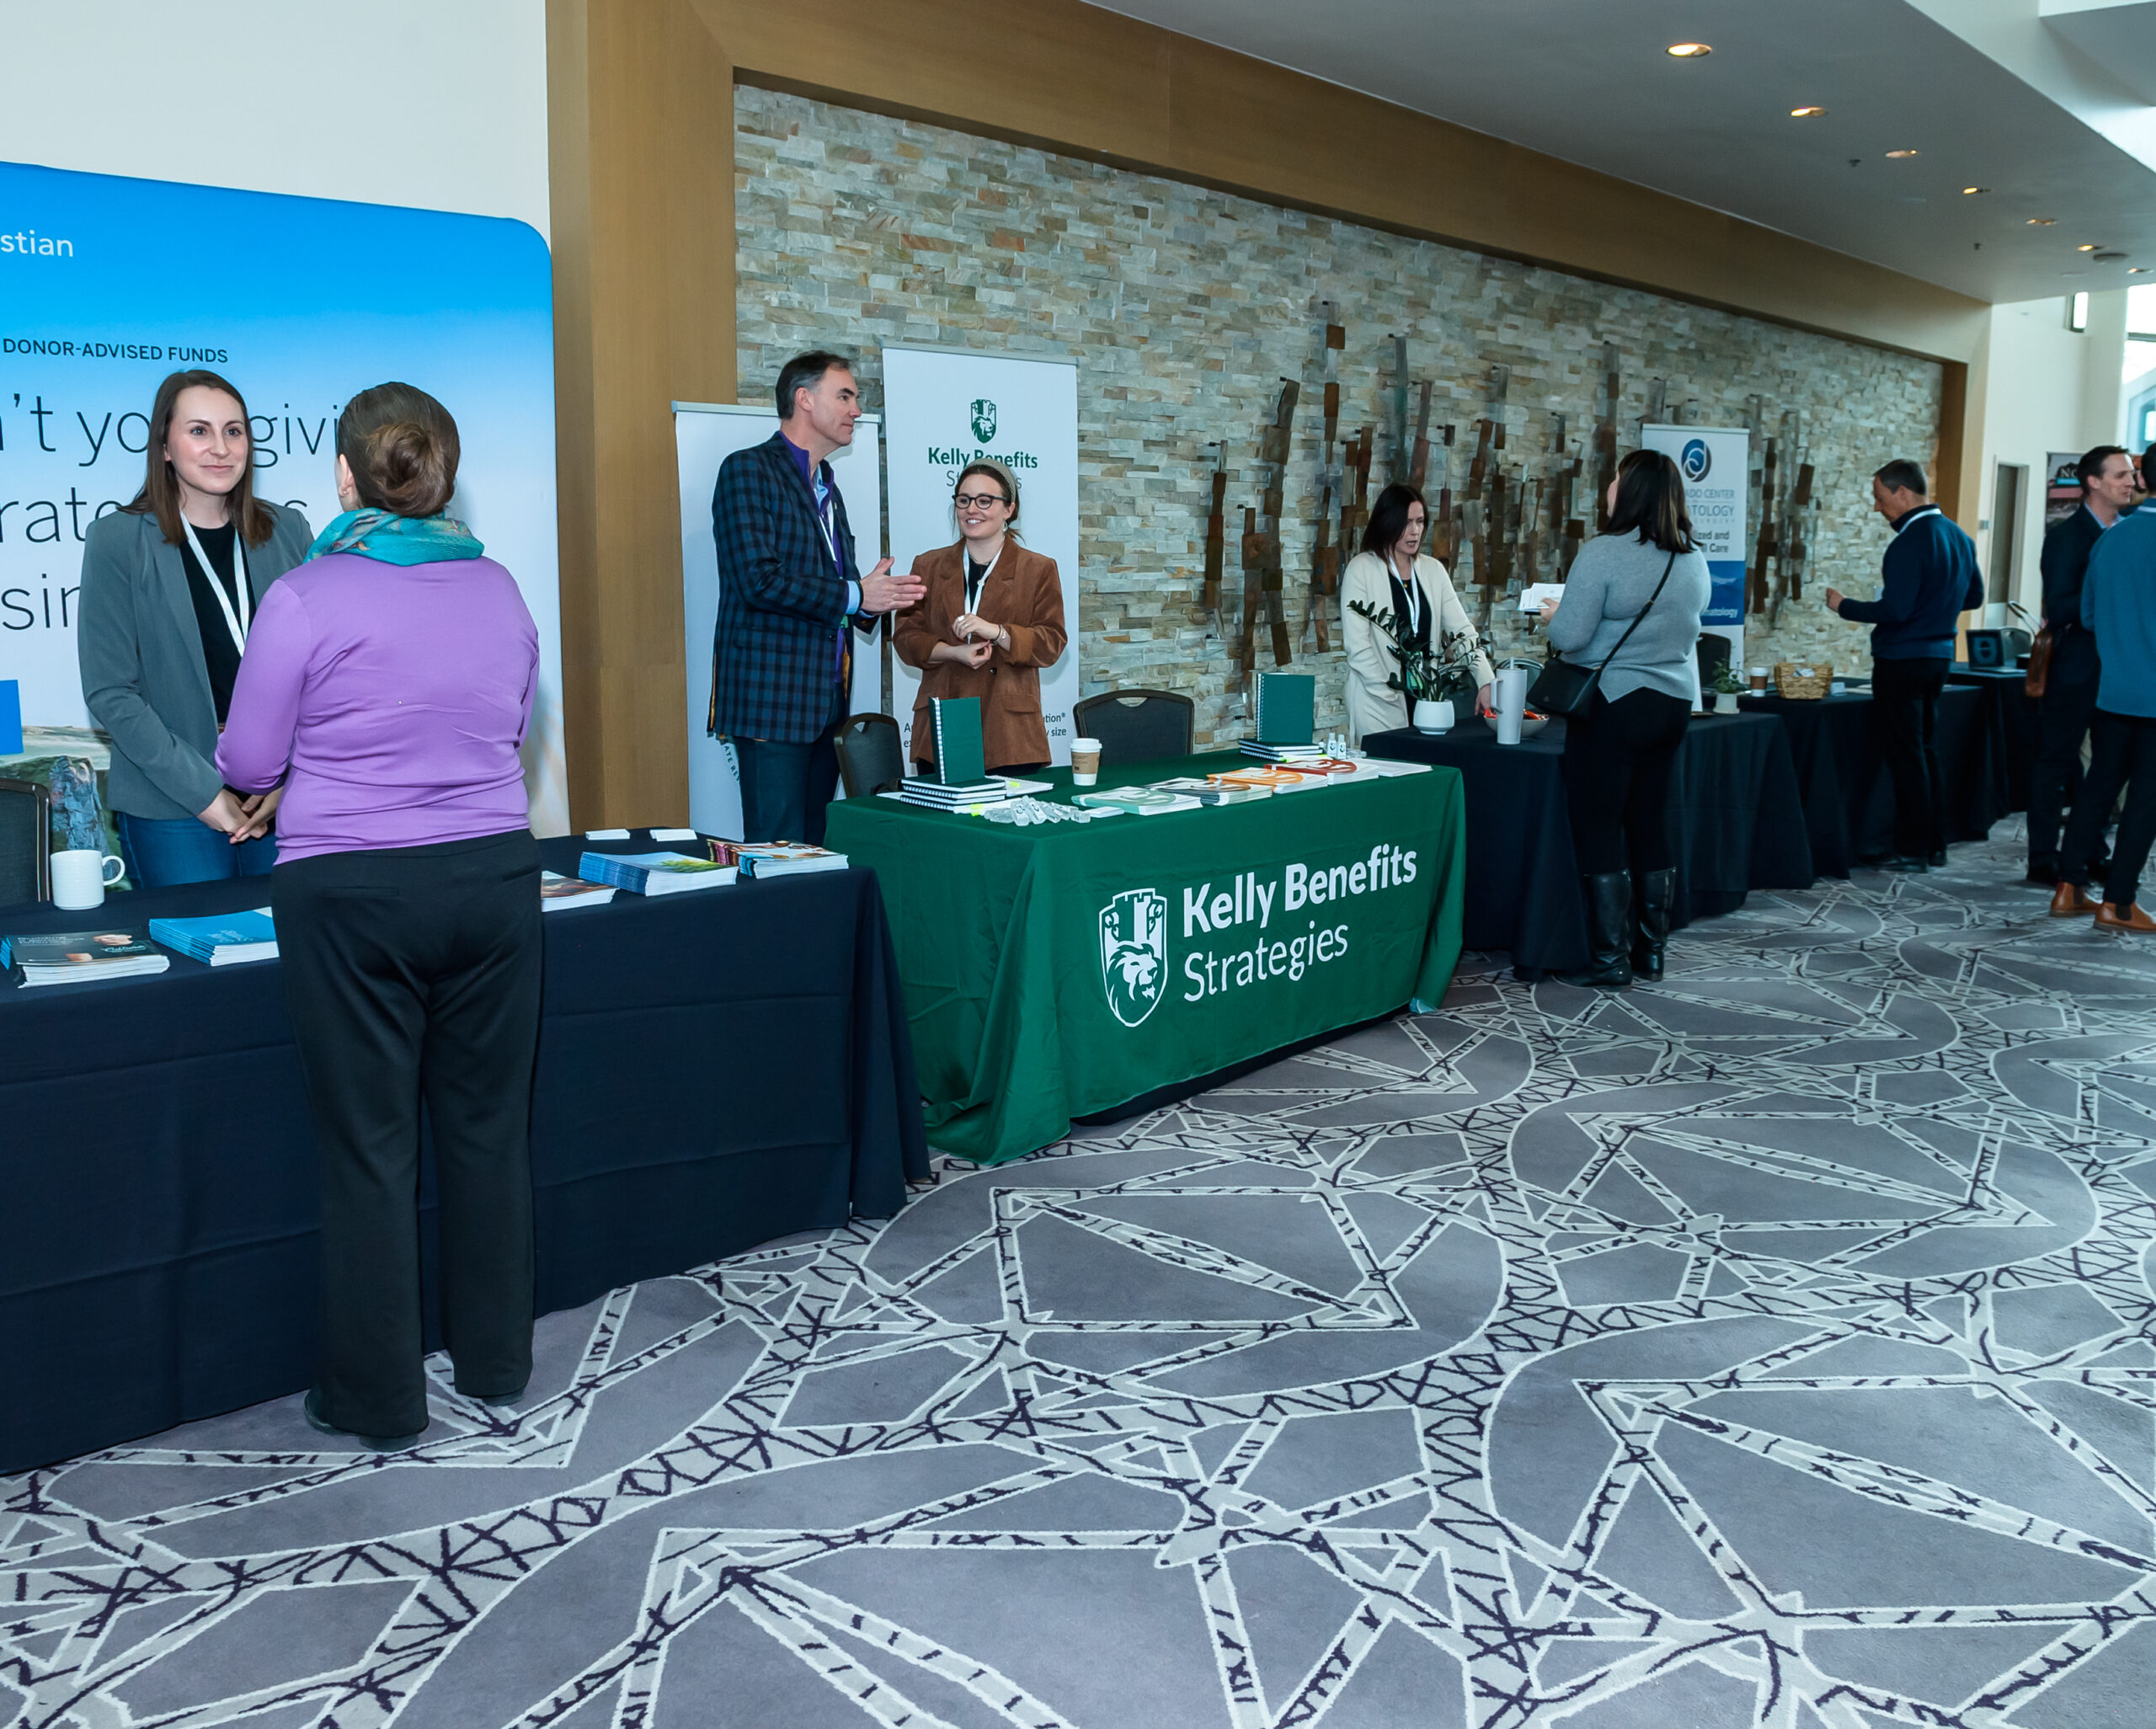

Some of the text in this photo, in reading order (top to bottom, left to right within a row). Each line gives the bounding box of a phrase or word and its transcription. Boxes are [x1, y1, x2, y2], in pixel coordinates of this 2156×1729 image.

[0, 229, 74, 257] stian
[3, 338, 228, 363] DONOR-ADVISED FUNDS
[928, 446, 970, 467] Kelly
[1710, 543, 1729, 552] Care
[1051, 727, 1067, 737] size
[1182, 843, 1417, 938] Kelly Benefits
[1183, 921, 1348, 1002] Strategies
